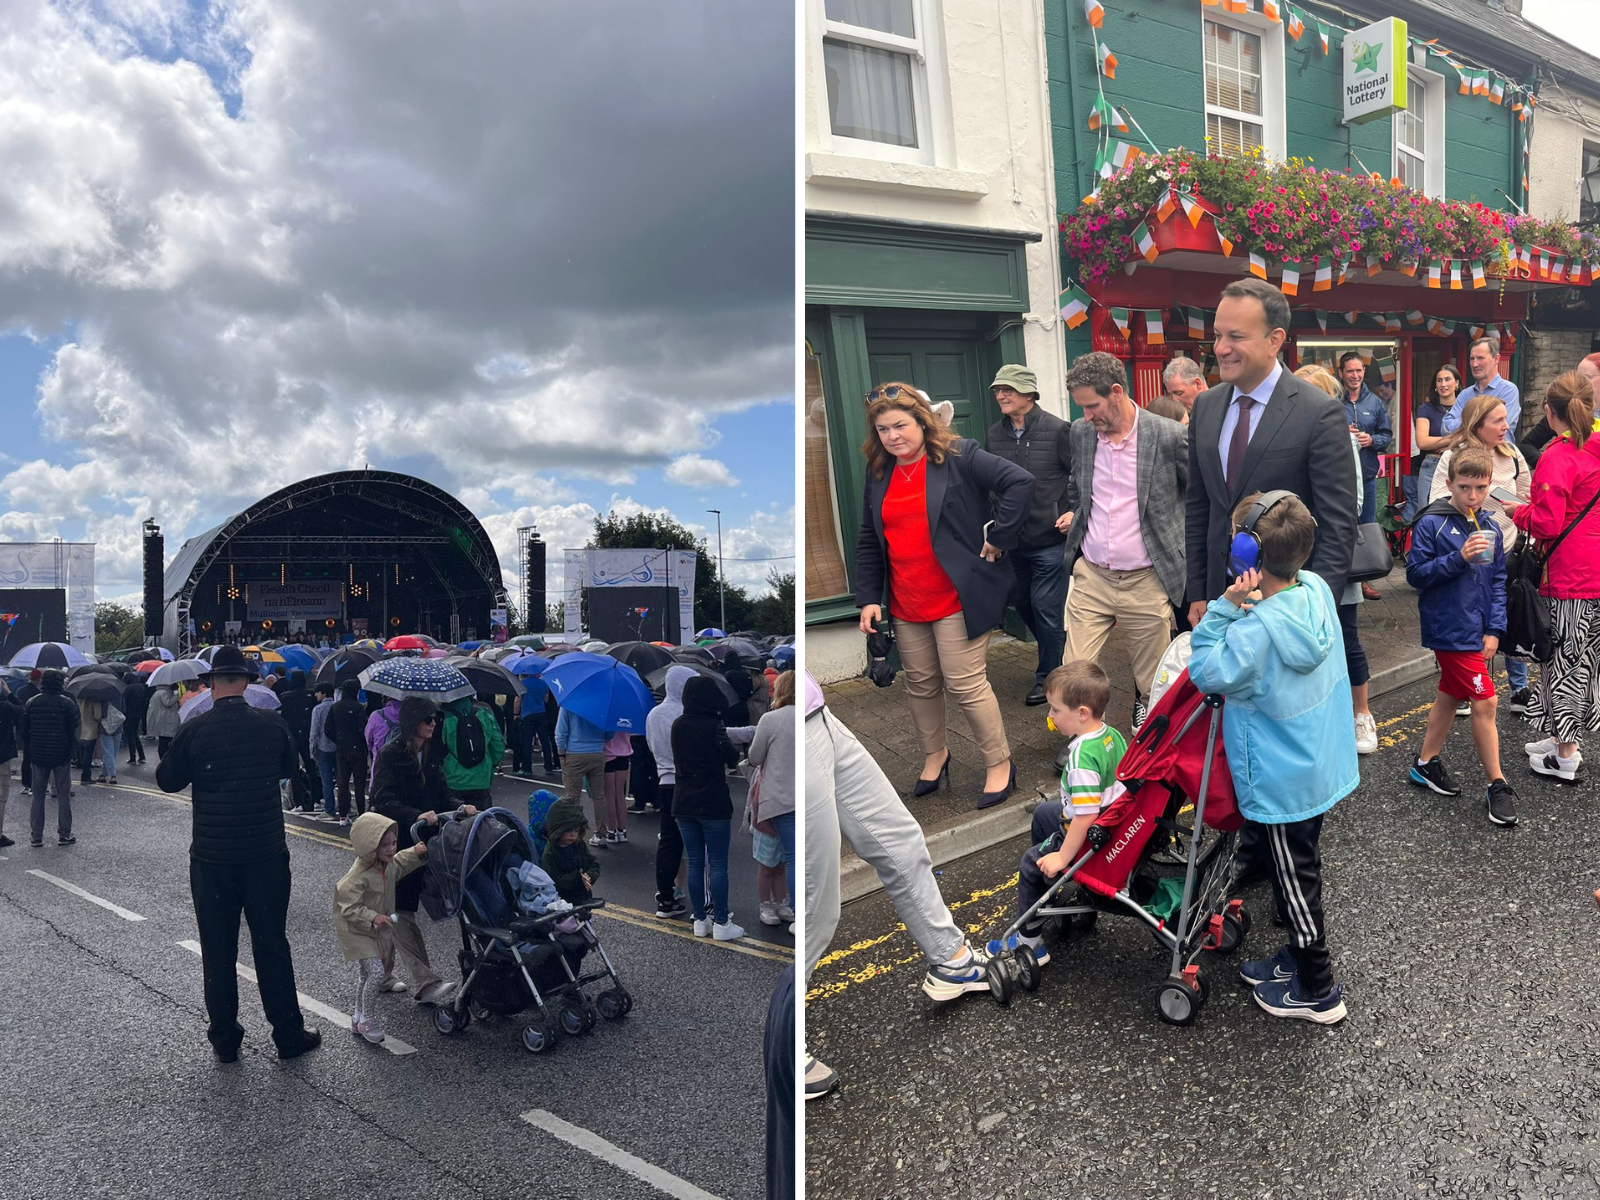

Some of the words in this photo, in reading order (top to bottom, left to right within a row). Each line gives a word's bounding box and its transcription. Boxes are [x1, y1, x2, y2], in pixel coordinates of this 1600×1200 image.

[1346, 73, 1389, 96] National
[1350, 86, 1386, 106] Lottery
[260, 583, 296, 595] Fleadh
[298, 583, 330, 594] Cheoil
[264, 598, 278, 607] na
[249, 609, 289, 619] Mullingar
[1105, 814, 1146, 864] MACLAREN
